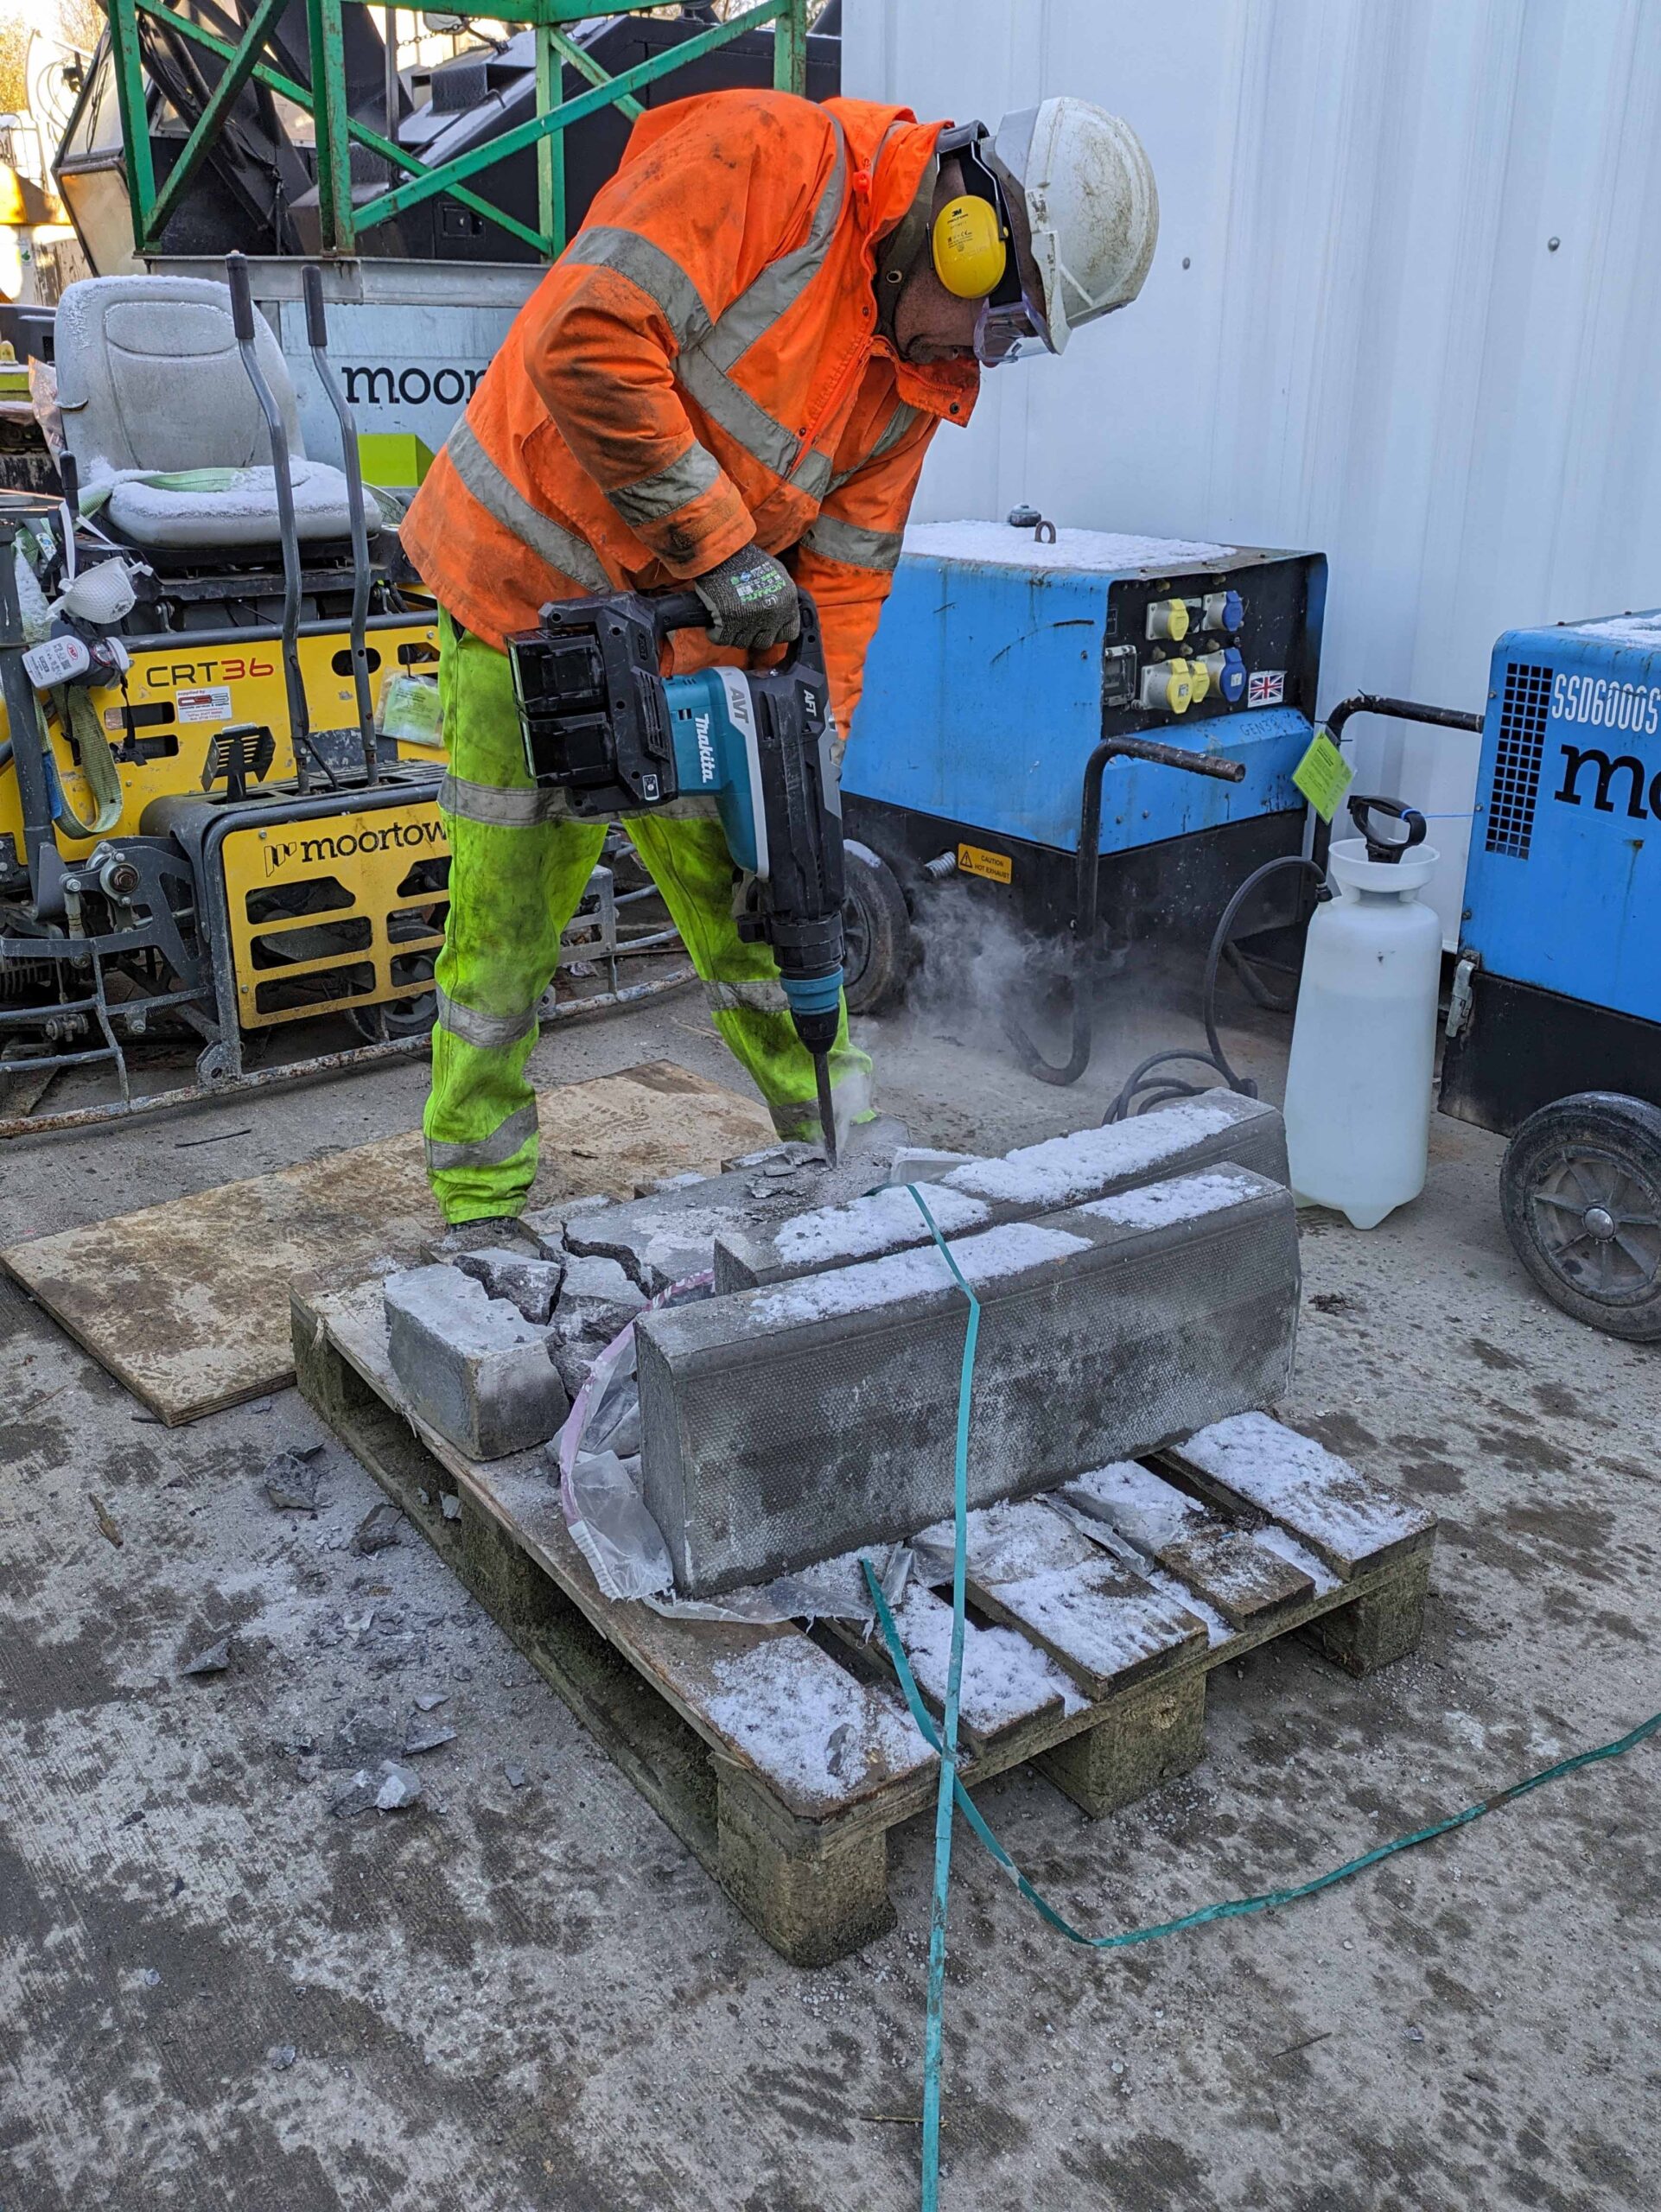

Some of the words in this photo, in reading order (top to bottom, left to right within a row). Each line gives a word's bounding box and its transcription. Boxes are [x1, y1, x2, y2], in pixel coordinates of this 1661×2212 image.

[341, 361, 490, 404] moor
[146, 658, 274, 688] CRT36
[729, 686, 749, 724] AVT
[804, 690, 817, 716] AFT
[1552, 673, 1661, 734] SSD6000S
[695, 714, 716, 784] Makita
[1554, 743, 1661, 821] m
[301, 822, 447, 862] moortow
[981, 855, 1004, 867] CAUTION
[985, 867, 1010, 879] EXHAUST
